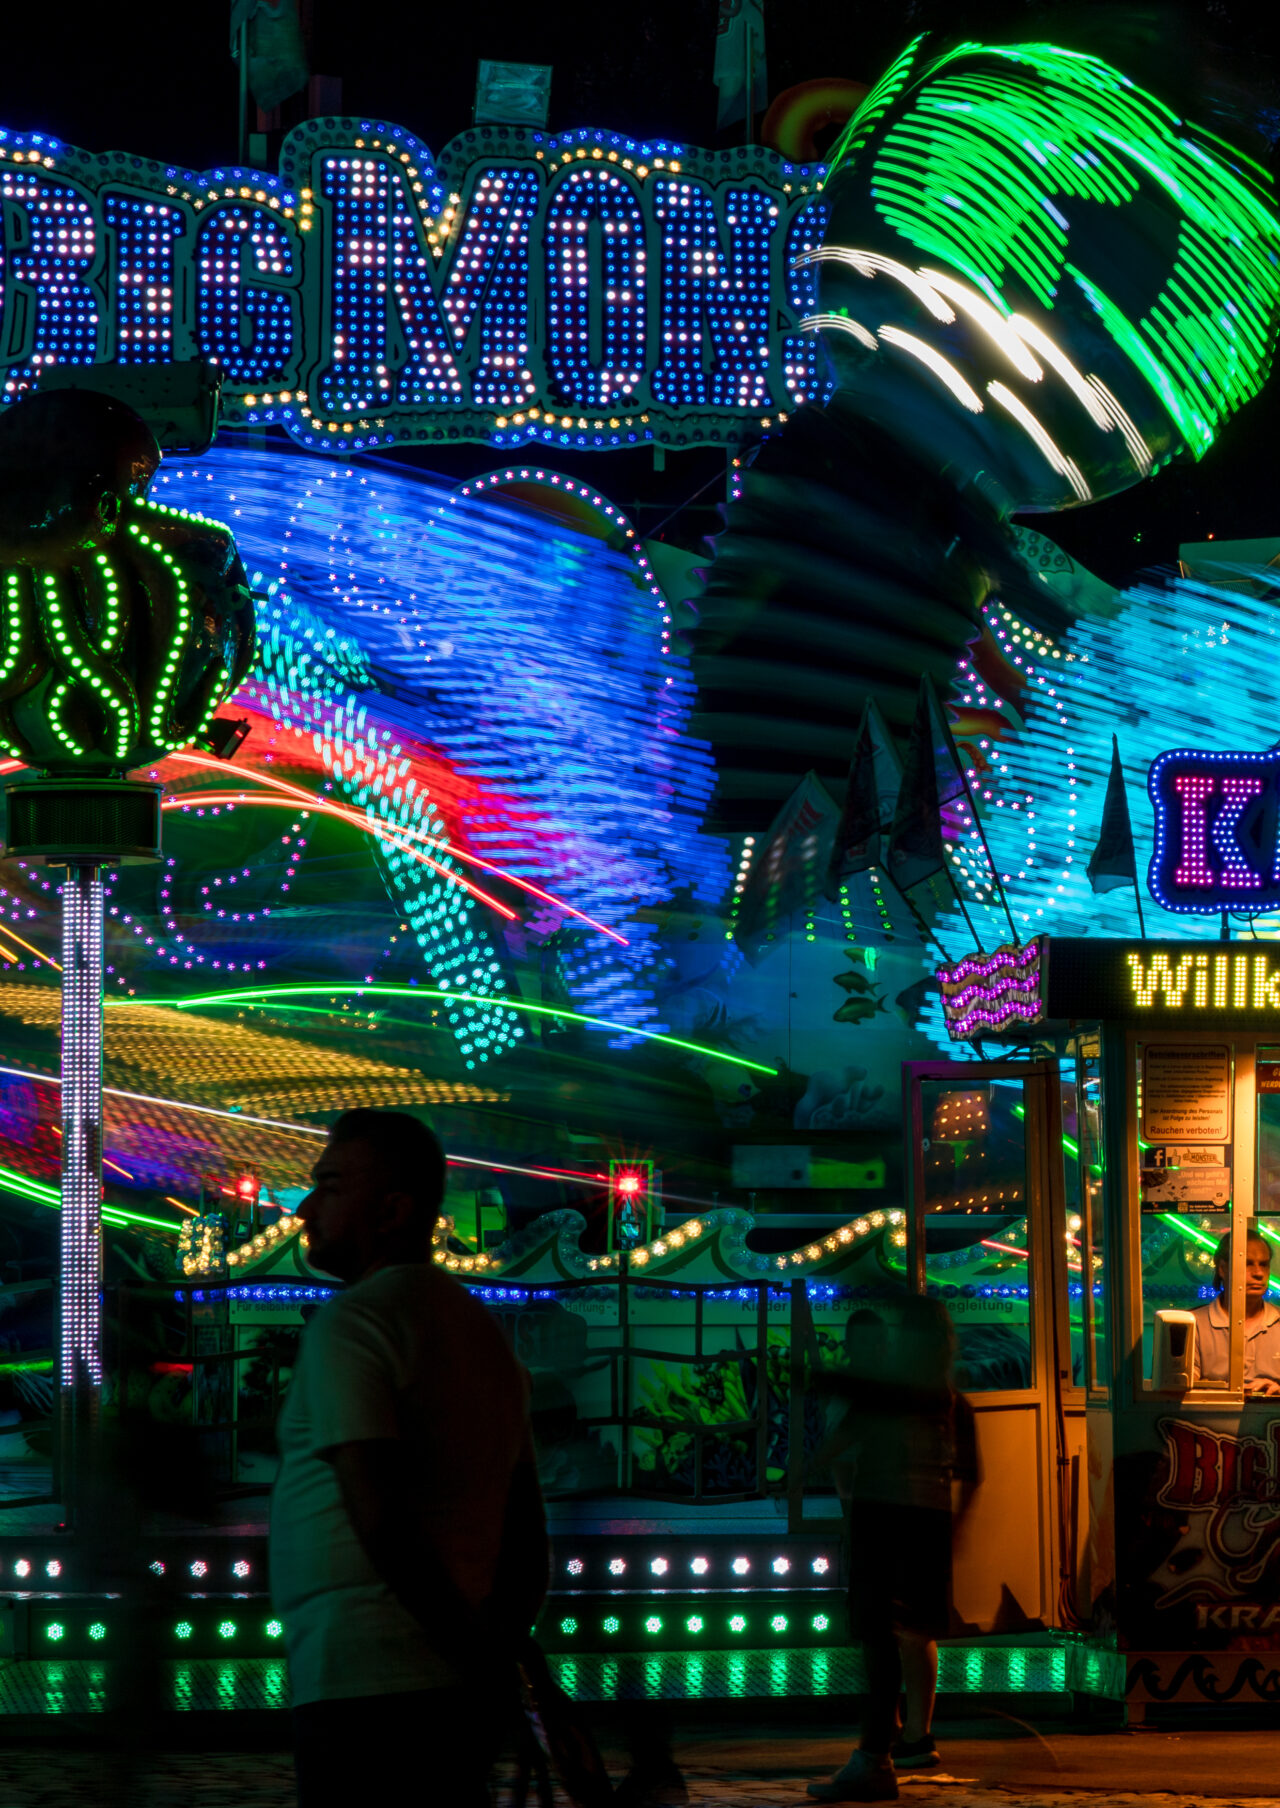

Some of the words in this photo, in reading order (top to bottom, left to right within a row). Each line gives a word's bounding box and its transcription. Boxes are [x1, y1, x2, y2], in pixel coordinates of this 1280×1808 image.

[1150, 1125, 1185, 1135] Rauchen
[1185, 1126, 1223, 1135] verboten!
[254, 1302, 302, 1312] selbstver
[741, 1300, 788, 1312] Kider
[945, 1300, 1014, 1313] egleitung
[1167, 1422, 1268, 1505] BIG
